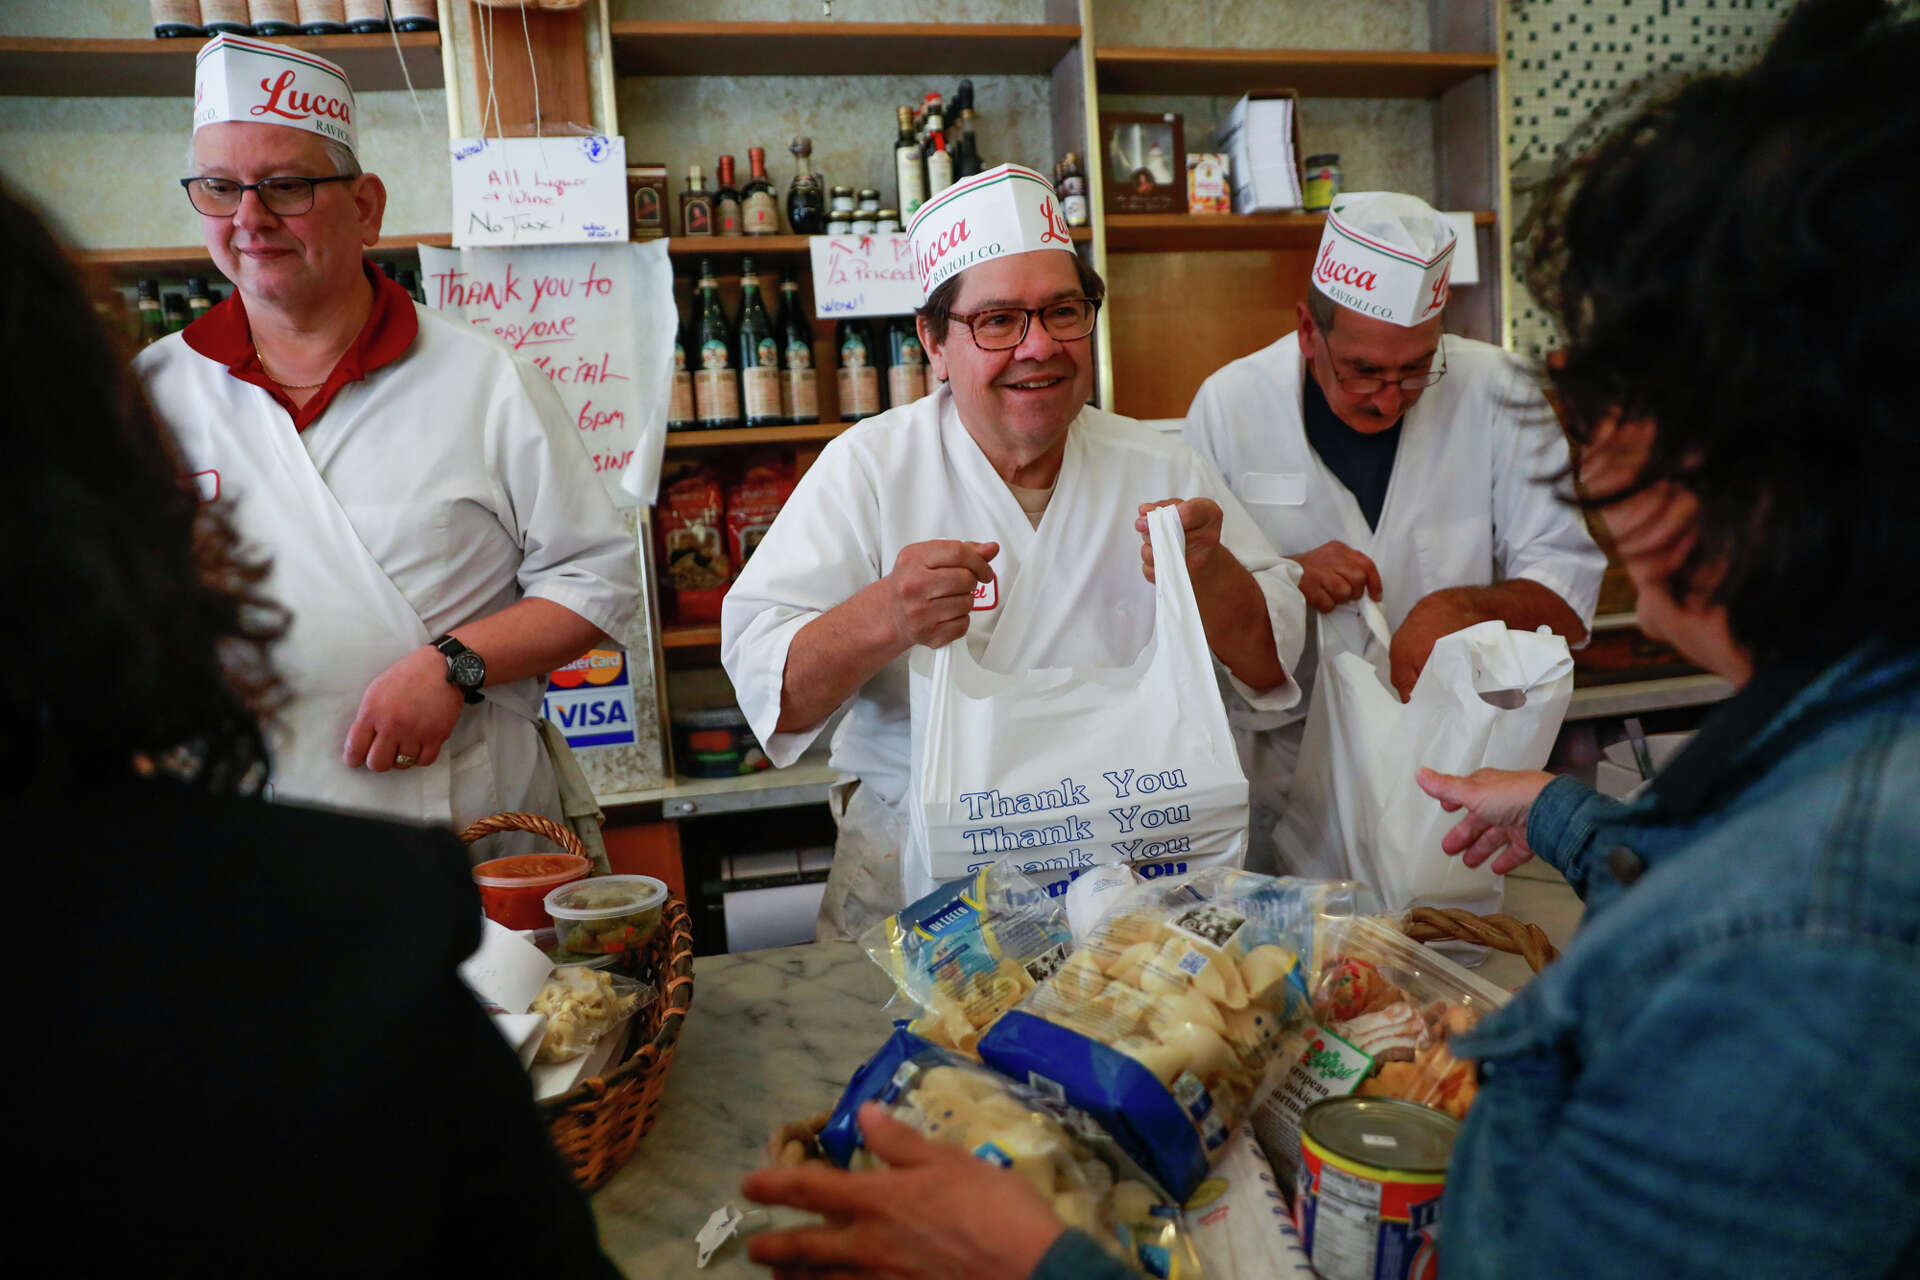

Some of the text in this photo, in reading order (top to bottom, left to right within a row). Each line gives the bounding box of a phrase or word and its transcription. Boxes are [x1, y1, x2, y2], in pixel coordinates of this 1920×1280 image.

[250, 69, 351, 125] Lucca
[468, 210, 504, 235] No
[579, 262, 613, 298] to
[932, 242, 1005, 285] RAVIOLI CO.
[1313, 239, 1378, 292] Lucca
[1329, 285, 1395, 320] RAVIOLI CO.
[554, 699, 628, 729] VISA
[960, 768, 1188, 821] Thank You
[963, 804, 1191, 856] Thank You
